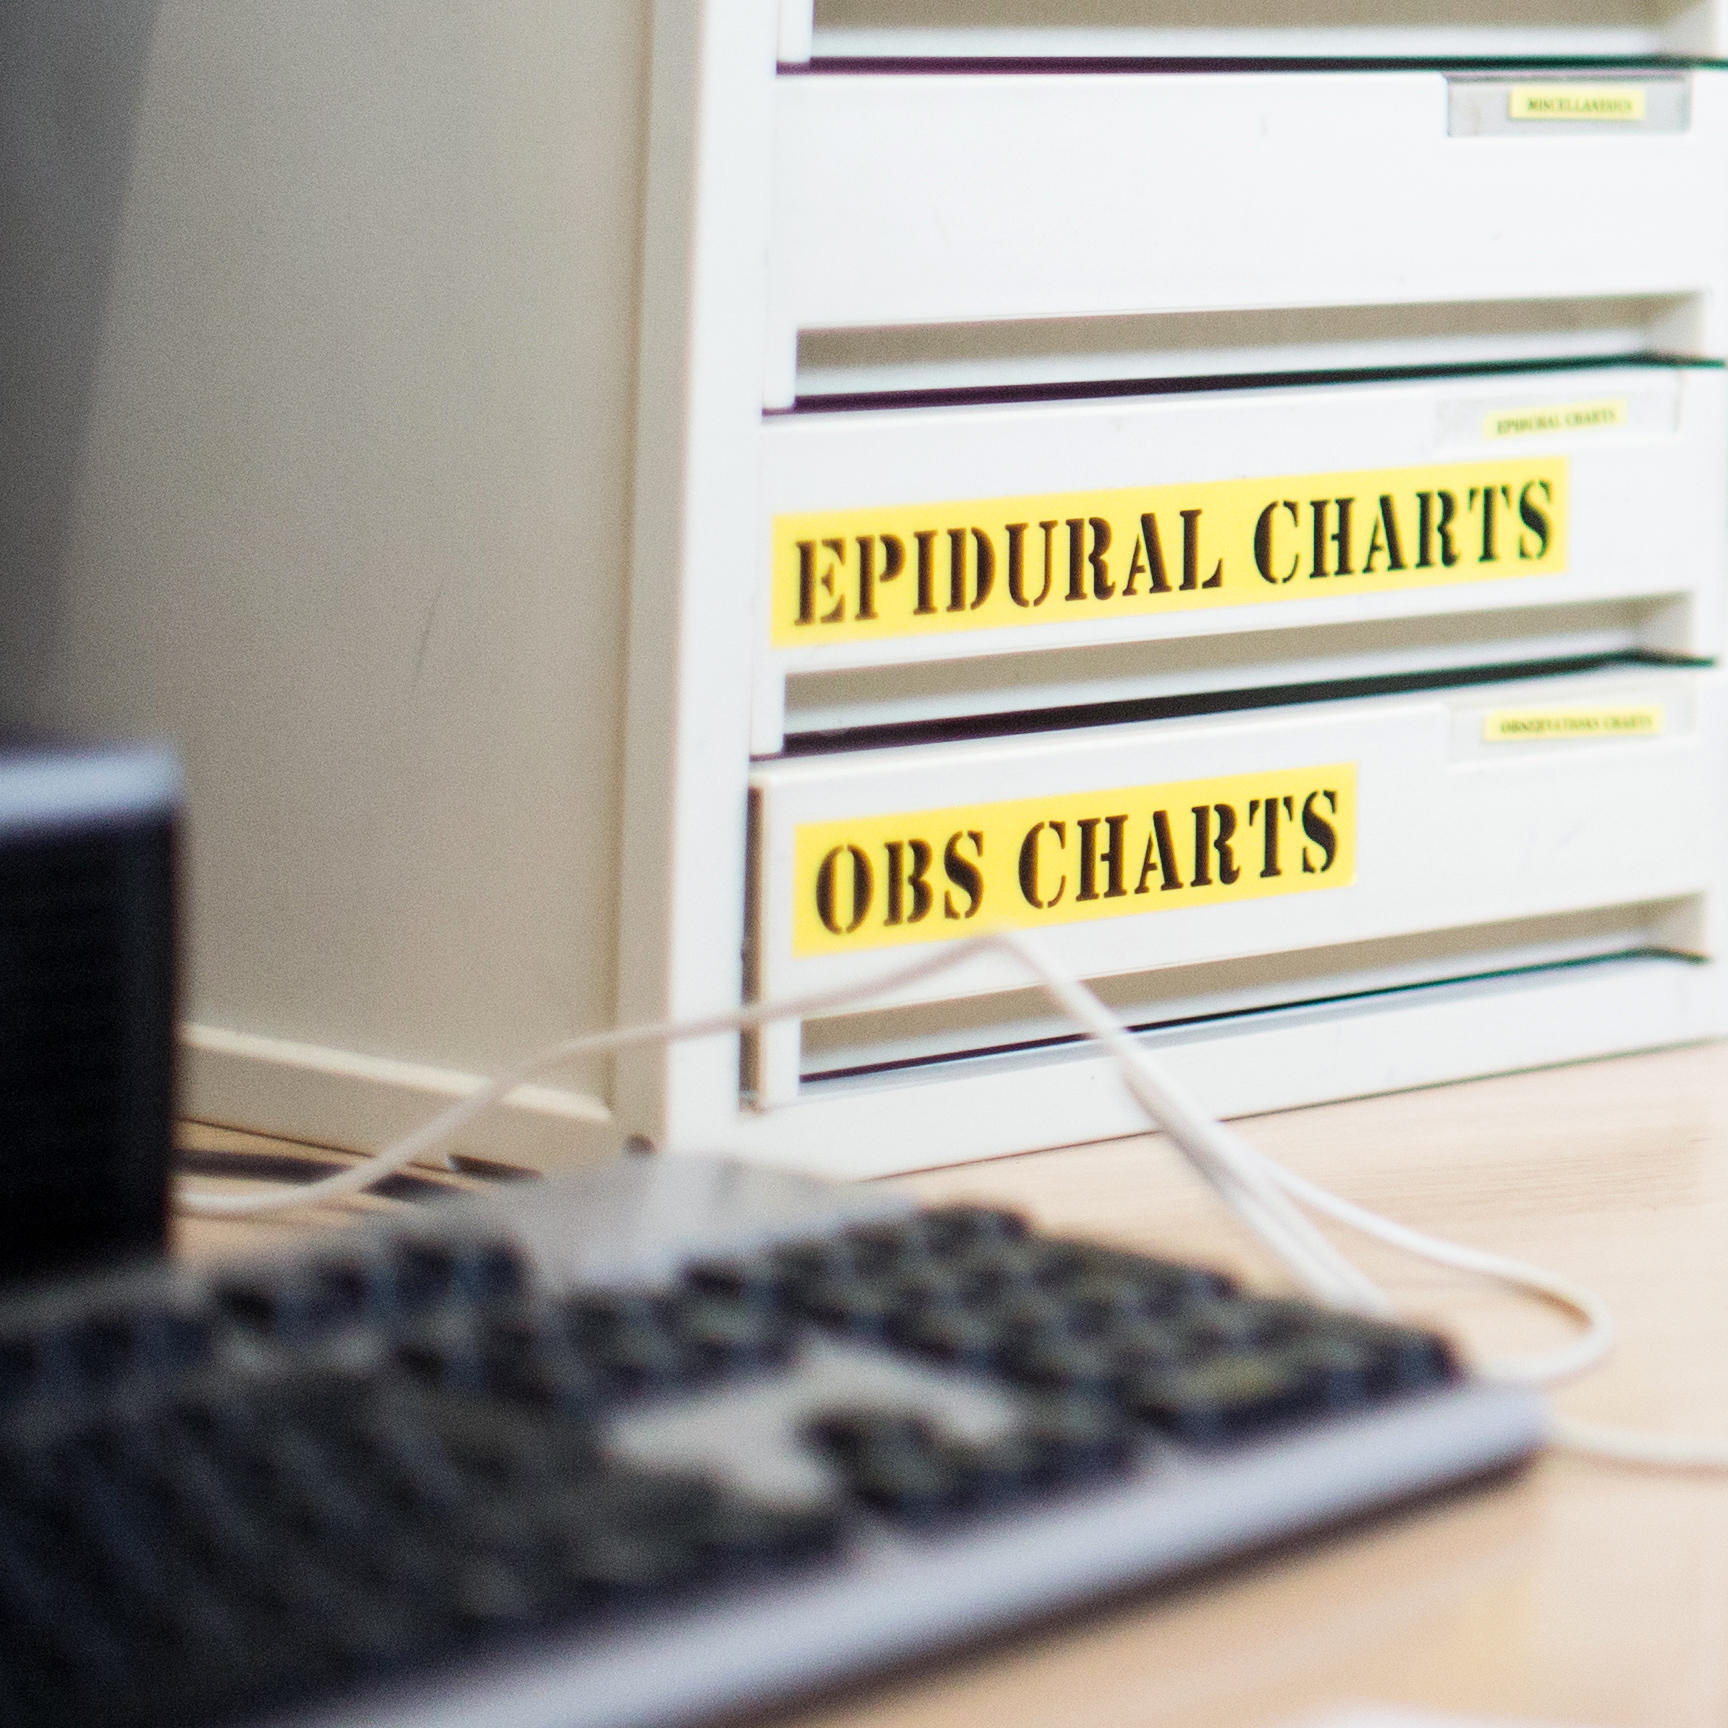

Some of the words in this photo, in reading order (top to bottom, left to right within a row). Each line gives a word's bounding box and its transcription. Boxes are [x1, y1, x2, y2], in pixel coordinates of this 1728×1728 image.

[793, 507, 1223, 626] EPIDURAL
[1252, 479, 1551, 585] CHARTS
[814, 829, 985, 935] OBS
[1017, 787, 1339, 910] CHARTS
